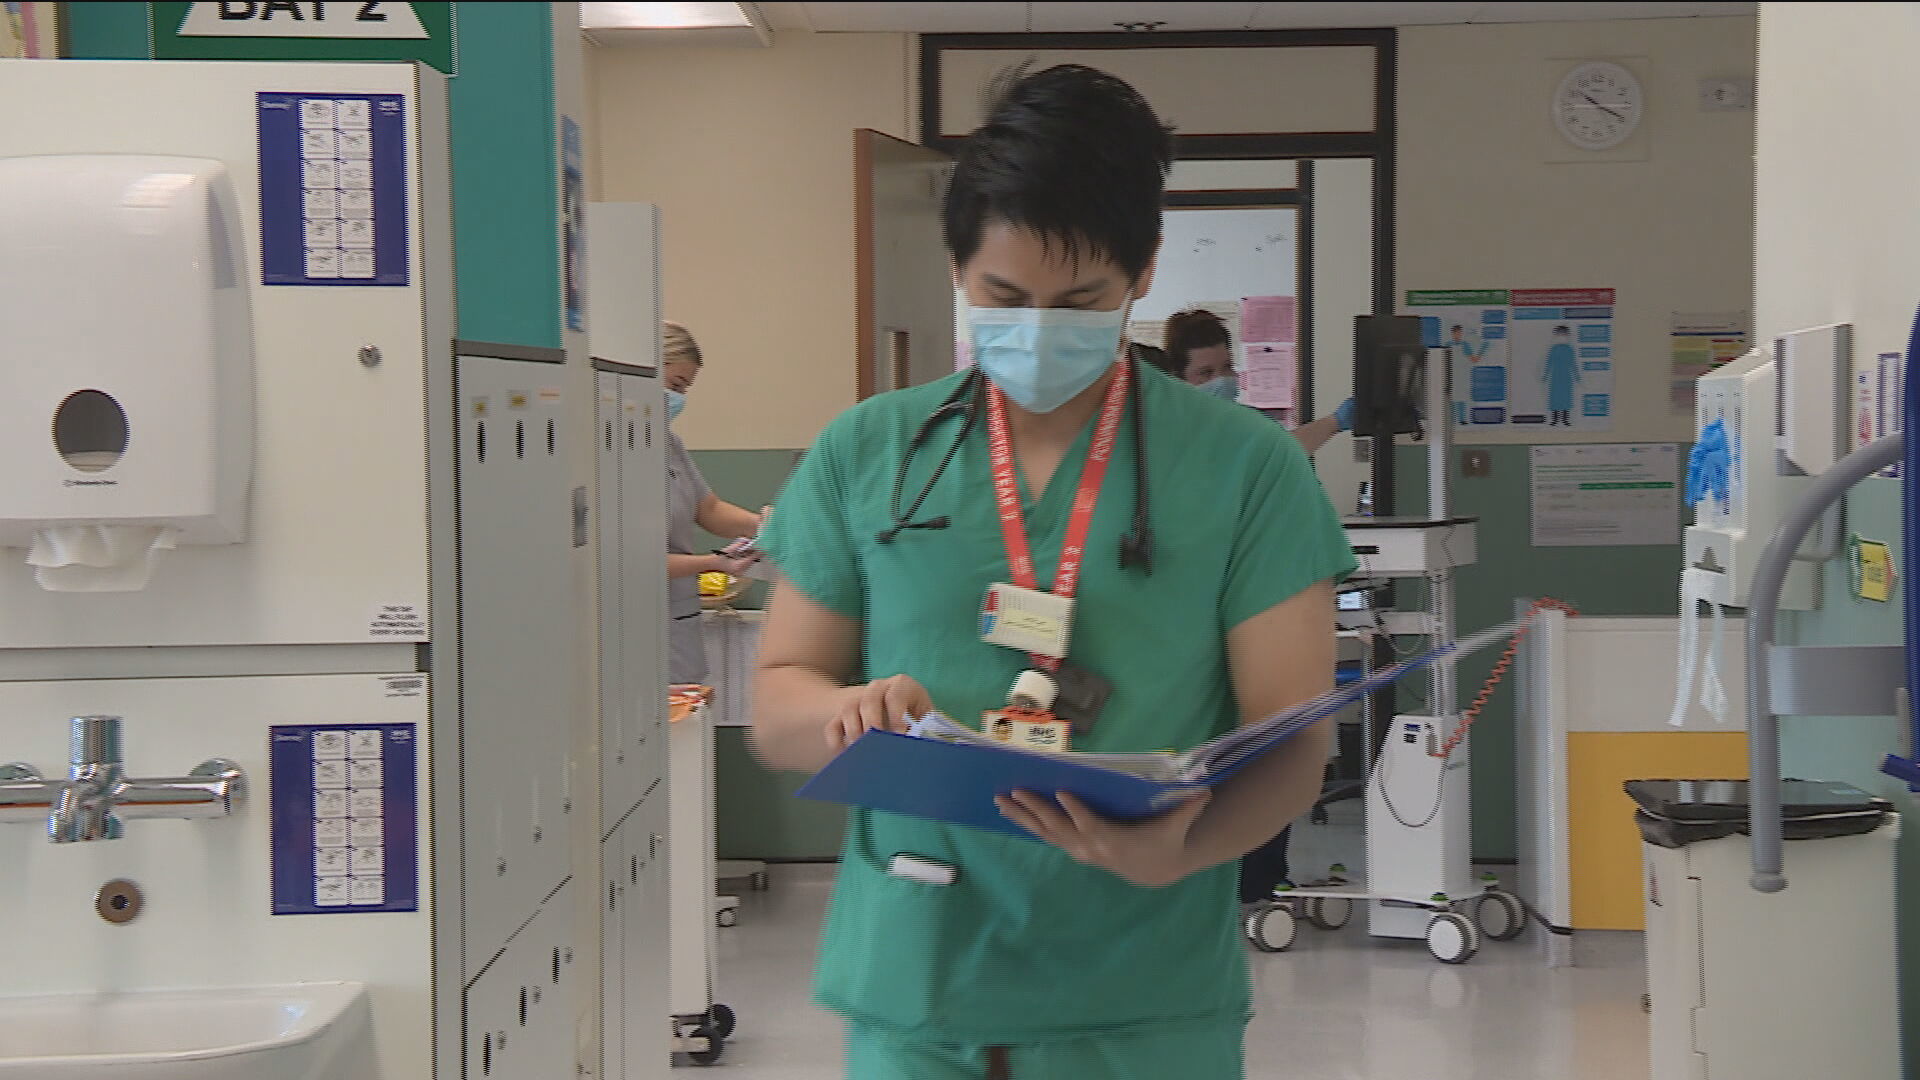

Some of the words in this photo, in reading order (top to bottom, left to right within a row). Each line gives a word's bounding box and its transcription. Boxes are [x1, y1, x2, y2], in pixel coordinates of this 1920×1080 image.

[218, 2, 325, 20] BA
[993, 468, 1018, 507] YEAR
[1056, 561, 1080, 598] EAR
